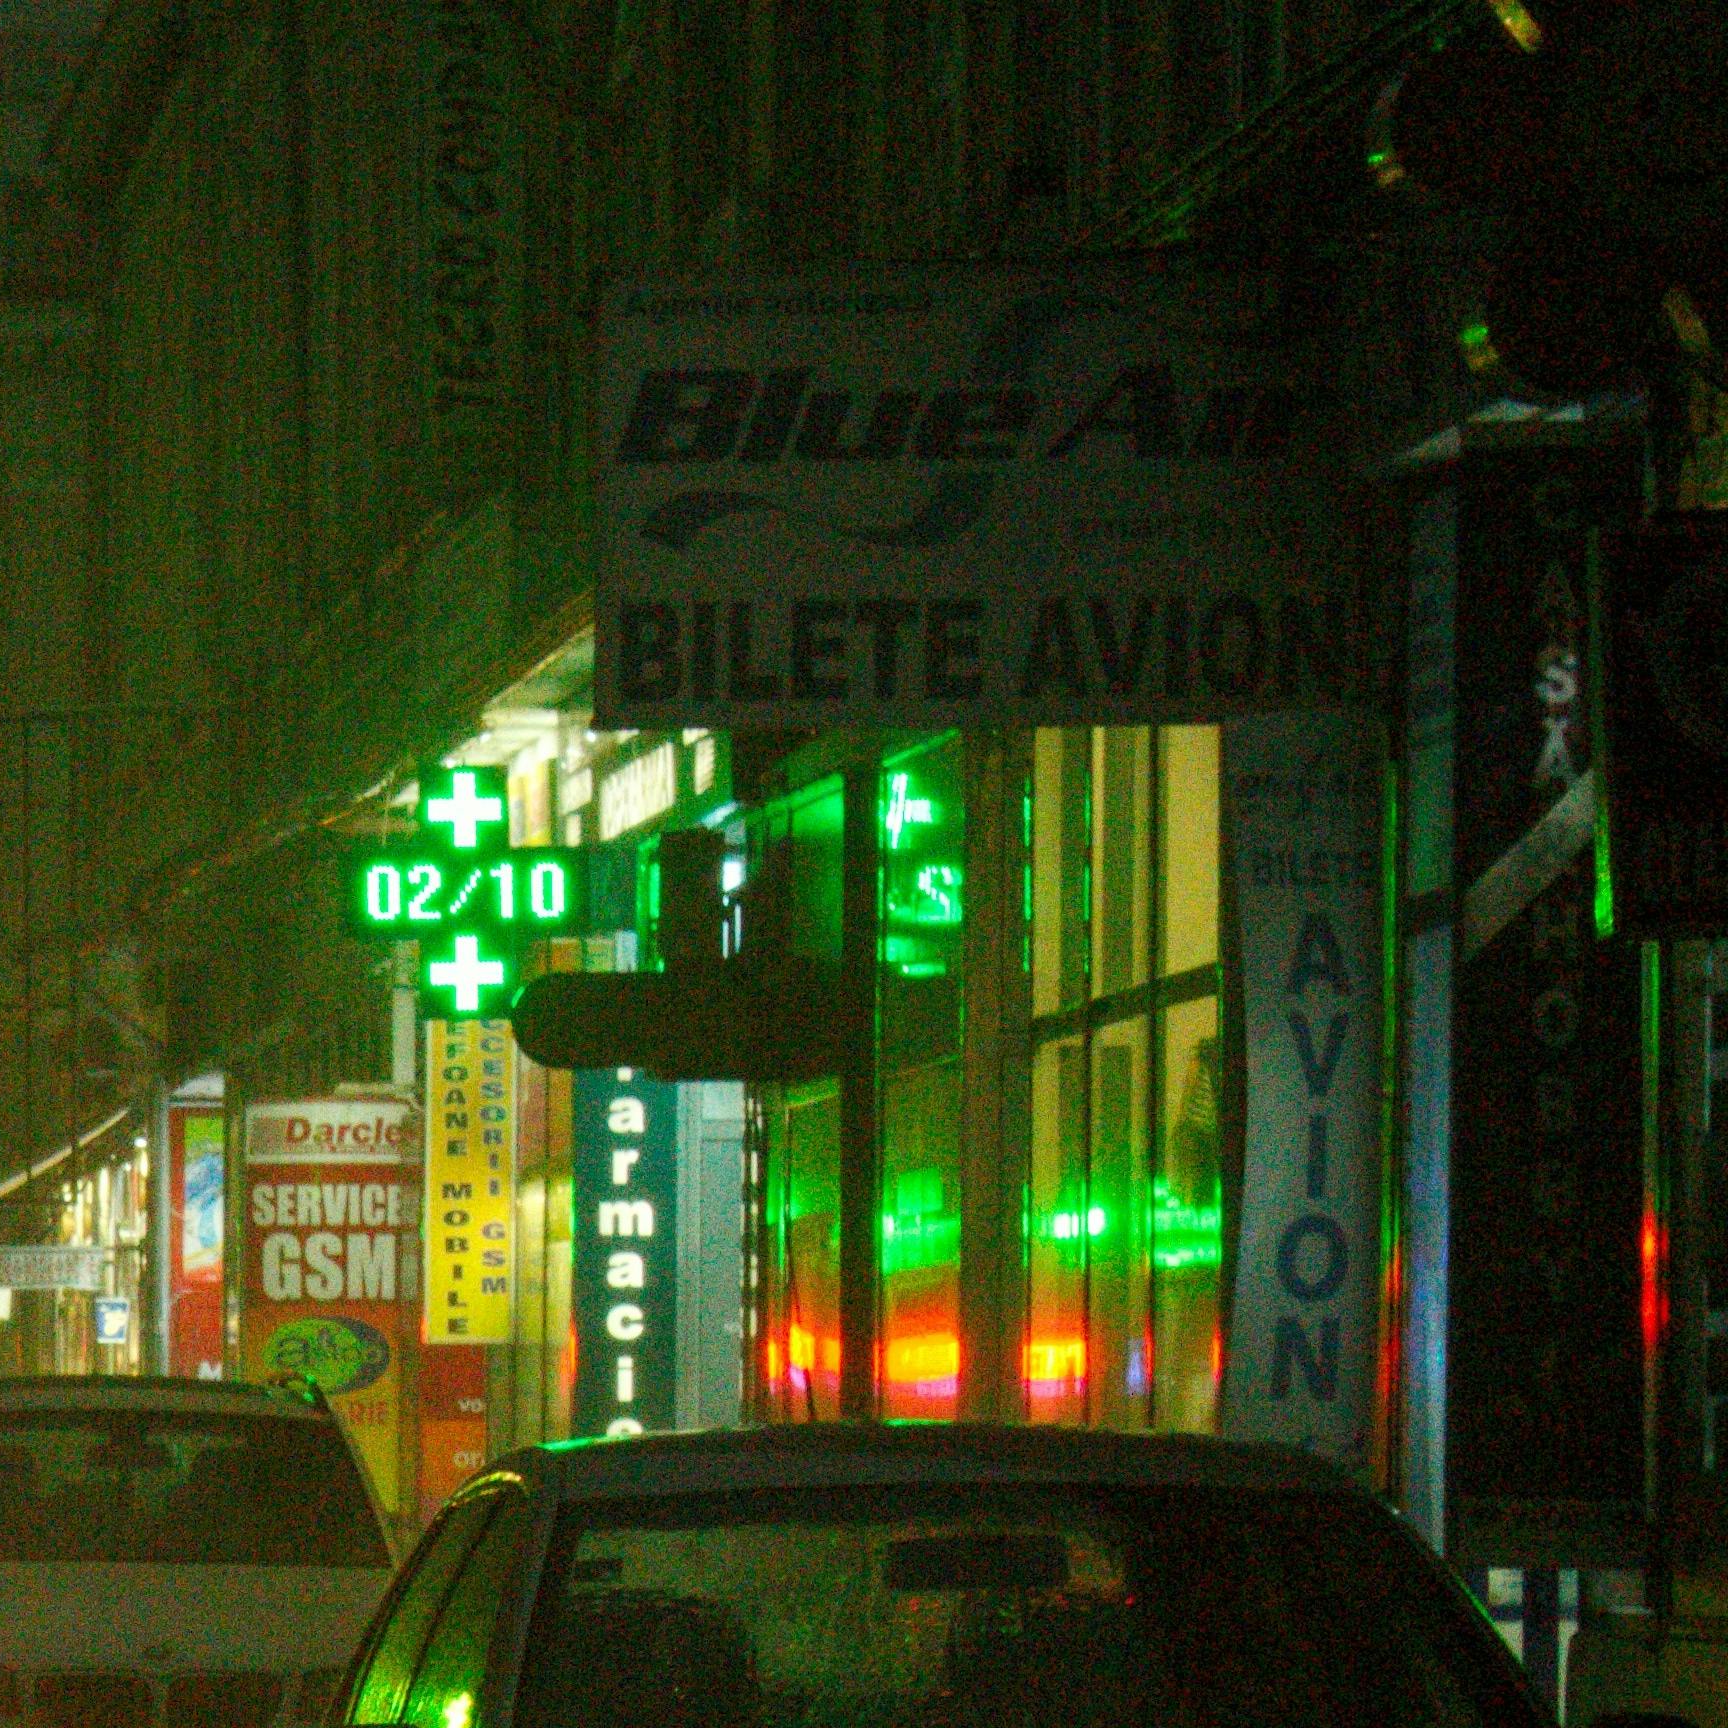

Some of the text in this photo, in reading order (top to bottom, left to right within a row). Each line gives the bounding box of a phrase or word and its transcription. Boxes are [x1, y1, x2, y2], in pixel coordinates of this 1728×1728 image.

[615, 363, 1344, 464] Blue Air
[615, 595, 1350, 702] BILETE AVION
[366, 862, 566, 921] 02/10
[285, 1115, 418, 1146] Darcle
[441, 1019, 473, 1335] EFOANE MOBILE
[478, 1018, 508, 1296] CCESORII GSM
[1270, 910, 1350, 1401] AVION
[251, 1182, 404, 1228] SERVICE
[598, 1066, 654, 1436] armaci
[261, 1232, 396, 1301] GSM
